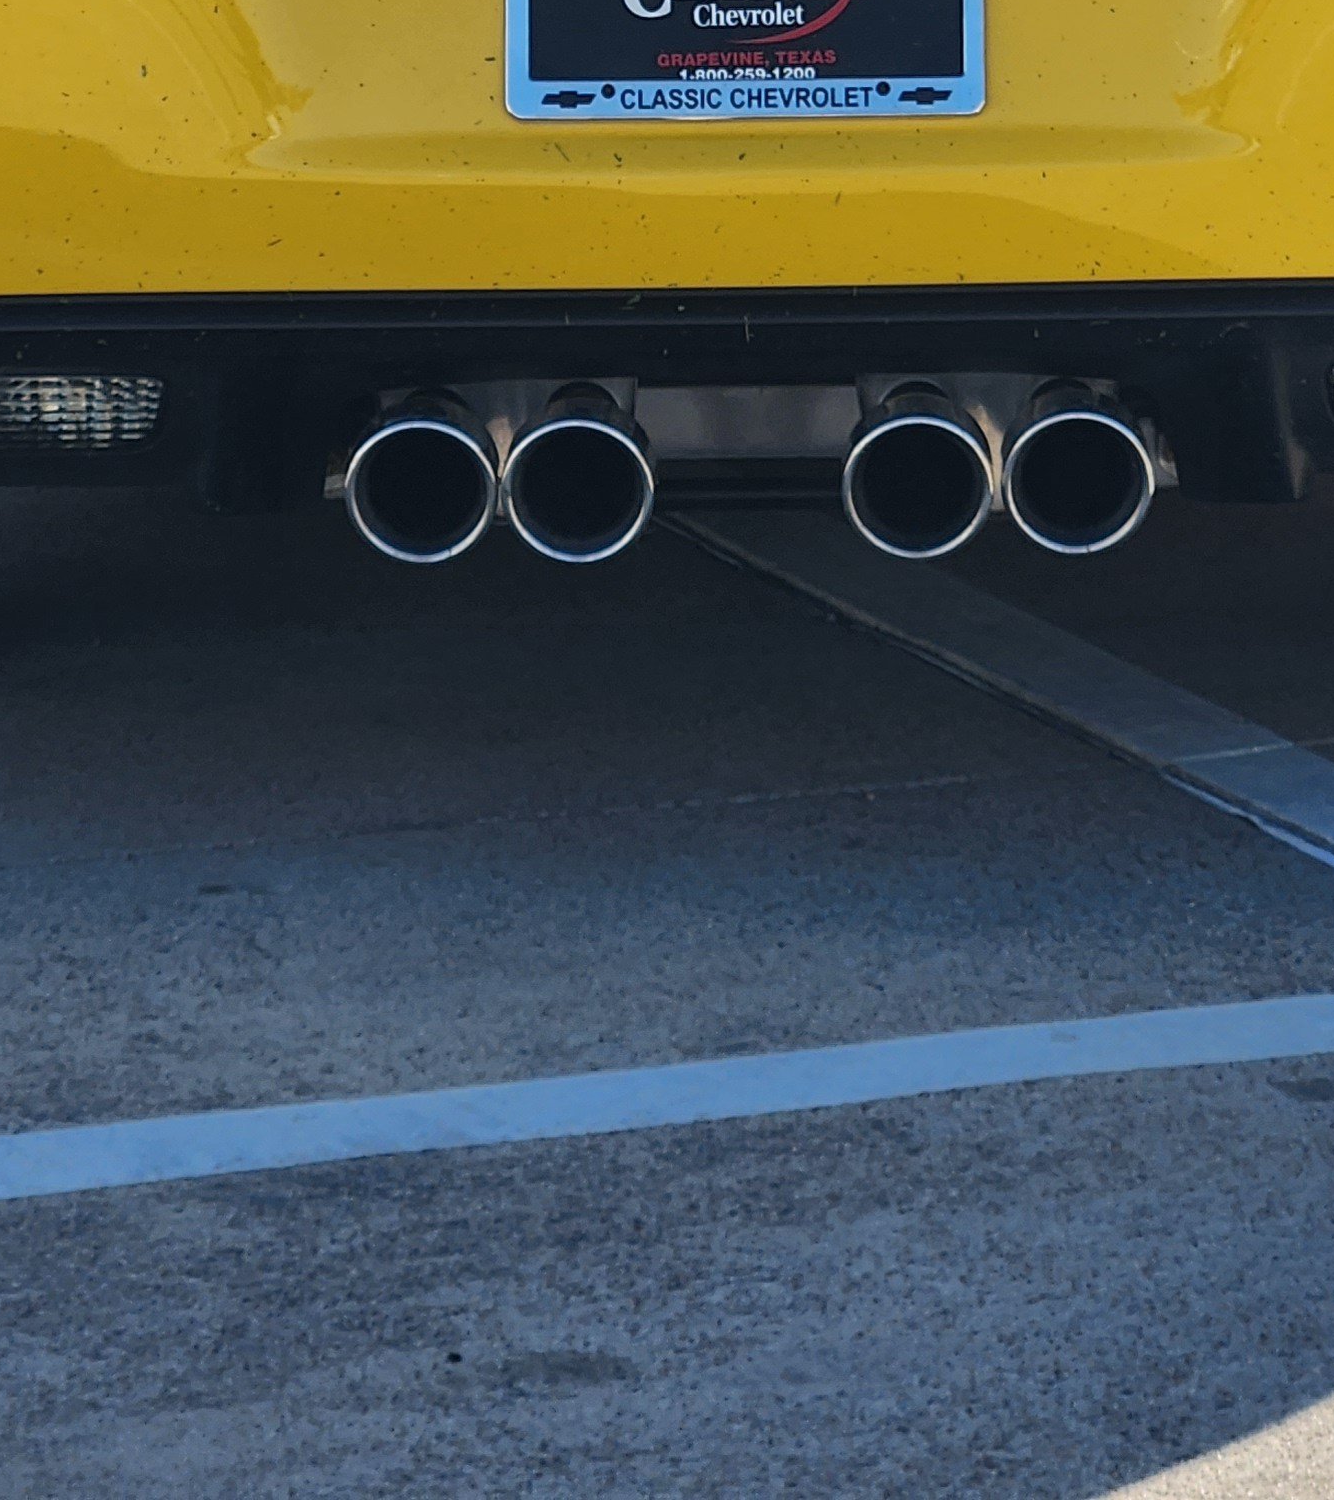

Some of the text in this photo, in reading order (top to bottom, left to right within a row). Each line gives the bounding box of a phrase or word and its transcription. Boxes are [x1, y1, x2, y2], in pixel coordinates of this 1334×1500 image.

[693, 2, 805, 27] Chevrolet
[657, 49, 837, 68] GRAPEVINE, TEXAS
[620, 86, 874, 110] CLASSIC CHEVROLET
